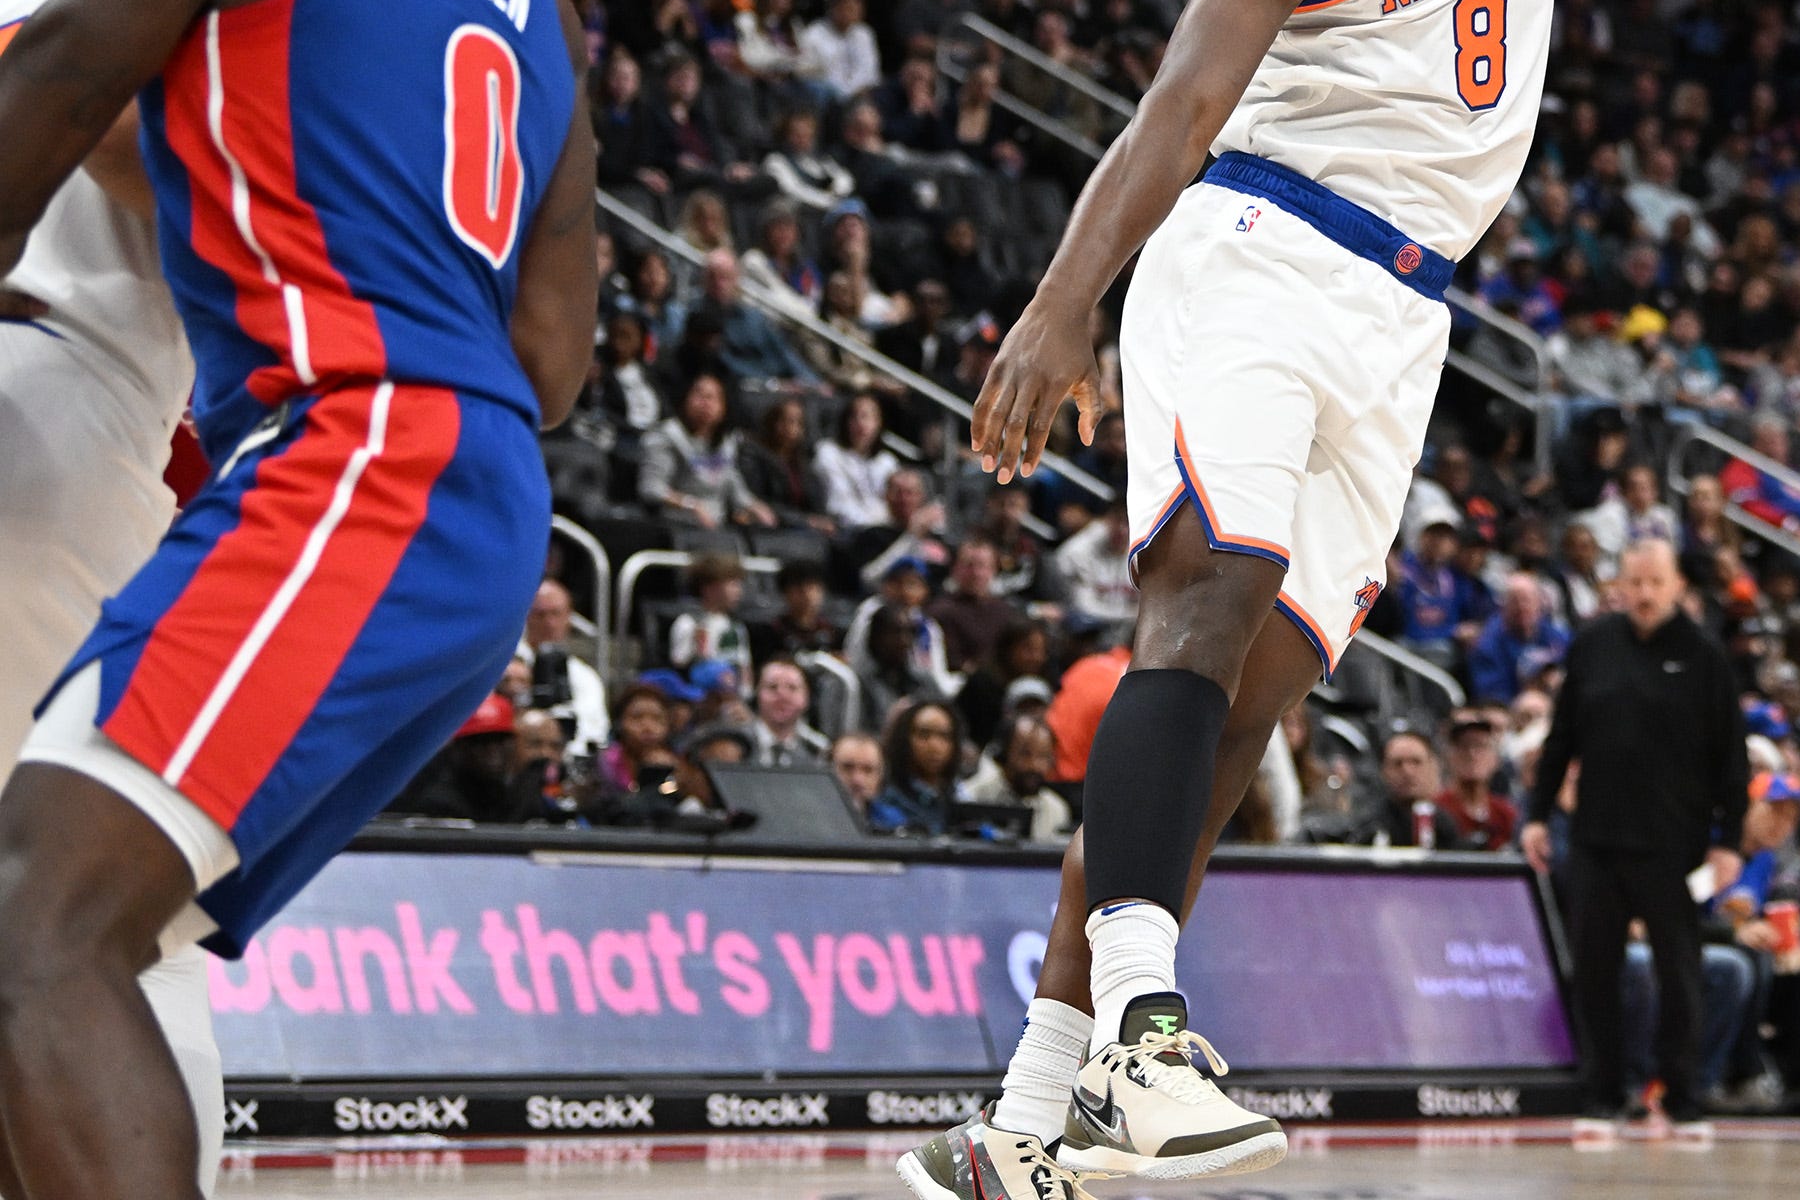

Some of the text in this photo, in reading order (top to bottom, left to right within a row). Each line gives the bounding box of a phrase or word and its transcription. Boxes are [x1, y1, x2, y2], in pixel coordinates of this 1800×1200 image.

[443, 23, 525, 270] 0
[207, 902, 478, 1015] bank
[479, 901, 773, 1017] that's
[773, 931, 986, 1054] your
[333, 1095, 469, 1130] StockX
[525, 1094, 655, 1130] StockX
[706, 1092, 829, 1128] StockX
[866, 1090, 984, 1125] StockX
[1417, 1083, 1520, 1118] StockX
